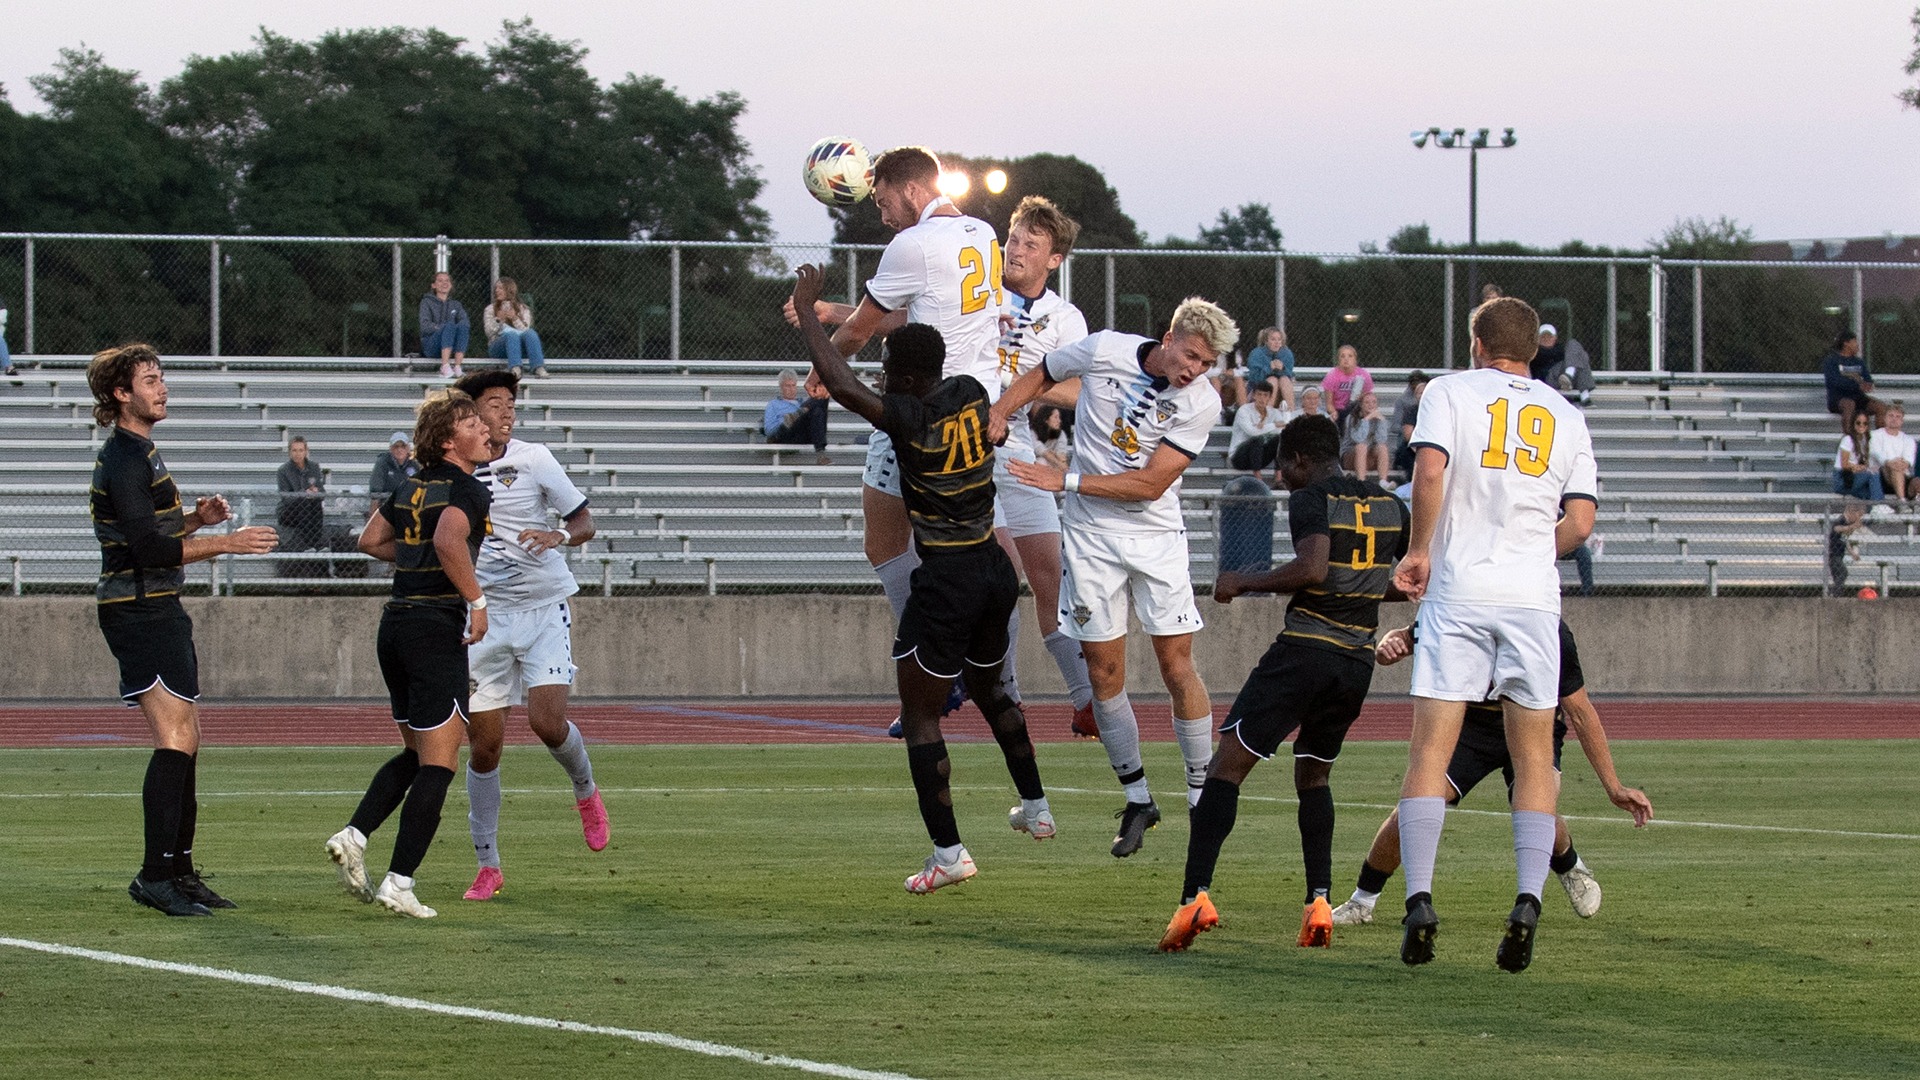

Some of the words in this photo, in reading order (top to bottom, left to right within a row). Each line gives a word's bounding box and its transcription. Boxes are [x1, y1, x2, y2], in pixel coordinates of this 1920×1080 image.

[958, 238, 1003, 315] 24
[1480, 397, 1556, 478] 19
[404, 487, 428, 545] 3
[1351, 503, 1375, 570] 5
